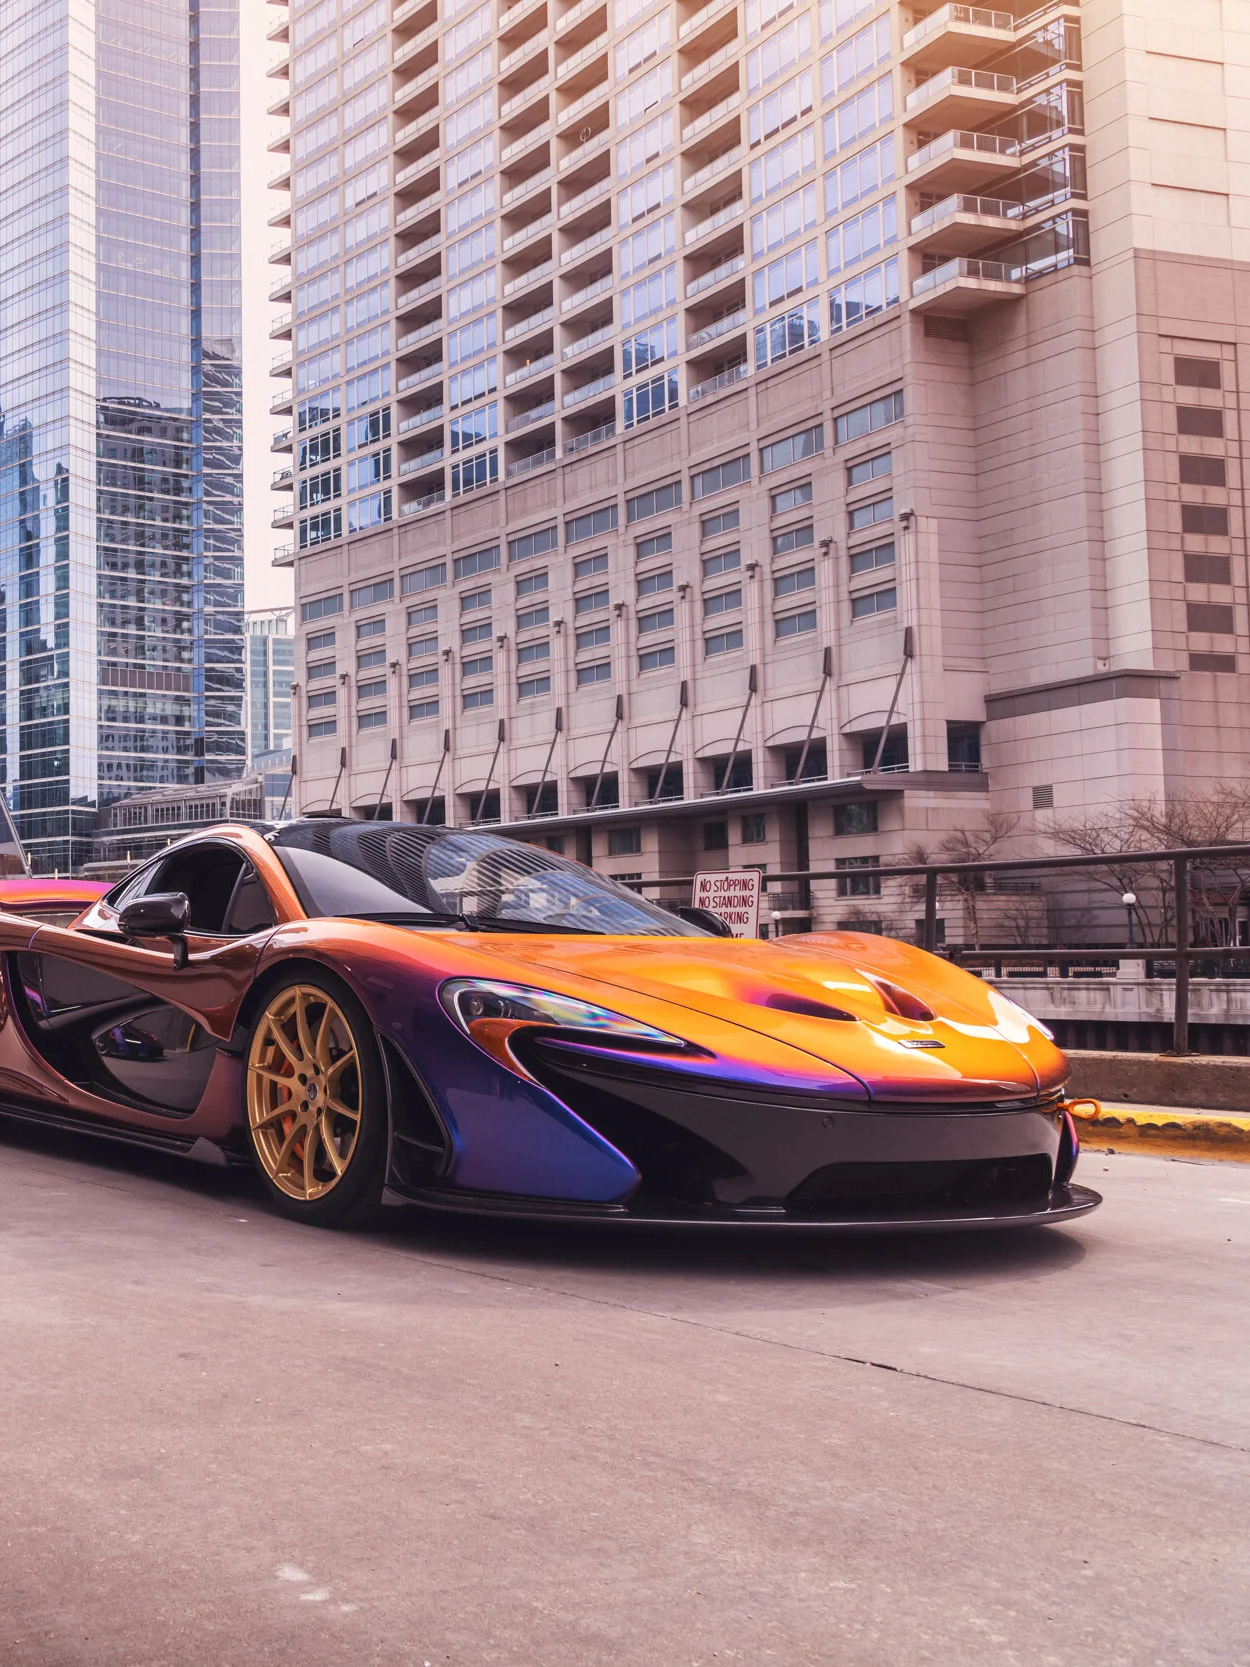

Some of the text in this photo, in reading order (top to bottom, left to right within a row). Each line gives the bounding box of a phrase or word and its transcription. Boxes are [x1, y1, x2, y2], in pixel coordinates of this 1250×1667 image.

[700, 878, 754, 892] NO STOPPING
[699, 895, 754, 909] NO STANDING
[714, 911, 749, 925] RKING
